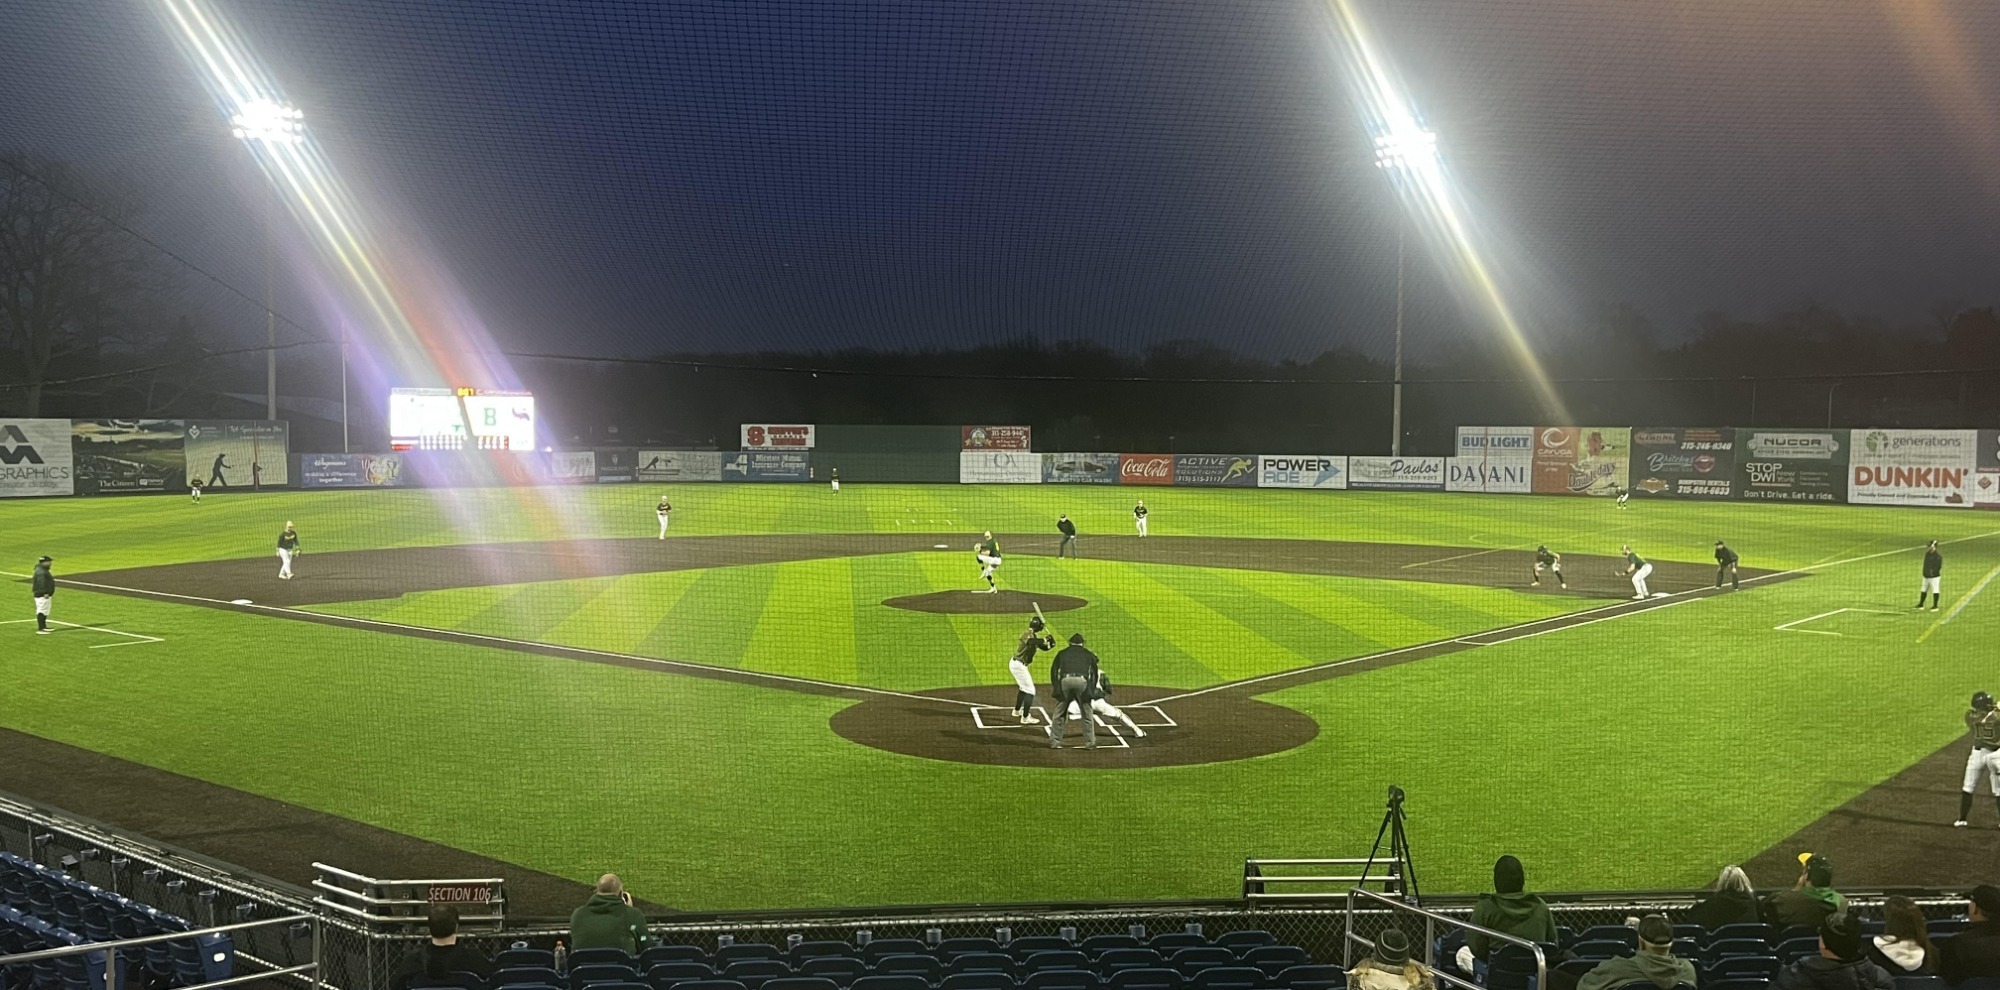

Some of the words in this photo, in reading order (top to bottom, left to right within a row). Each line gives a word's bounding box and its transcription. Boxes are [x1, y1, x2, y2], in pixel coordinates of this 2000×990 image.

[1462, 437, 1488, 448] BUD
[1490, 437, 1529, 448] LIGHT
[1763, 438, 1822, 446] NUCOR
[1891, 436, 1961, 449] generations
[1179, 457, 1228, 466] ACTIVE
[1263, 458, 1331, 472] POWER
[1746, 463, 1783, 473] STOP
[1263, 471, 1300, 483] ADE
[1450, 461, 1524, 487] DASANI
[1750, 472, 1776, 482] DWI
[1854, 466, 1969, 489] DUNKIN'
[1743, 490, 1765, 498] Don't
[427, 887, 471, 901] SECTION
[473, 887, 492, 901] 106
